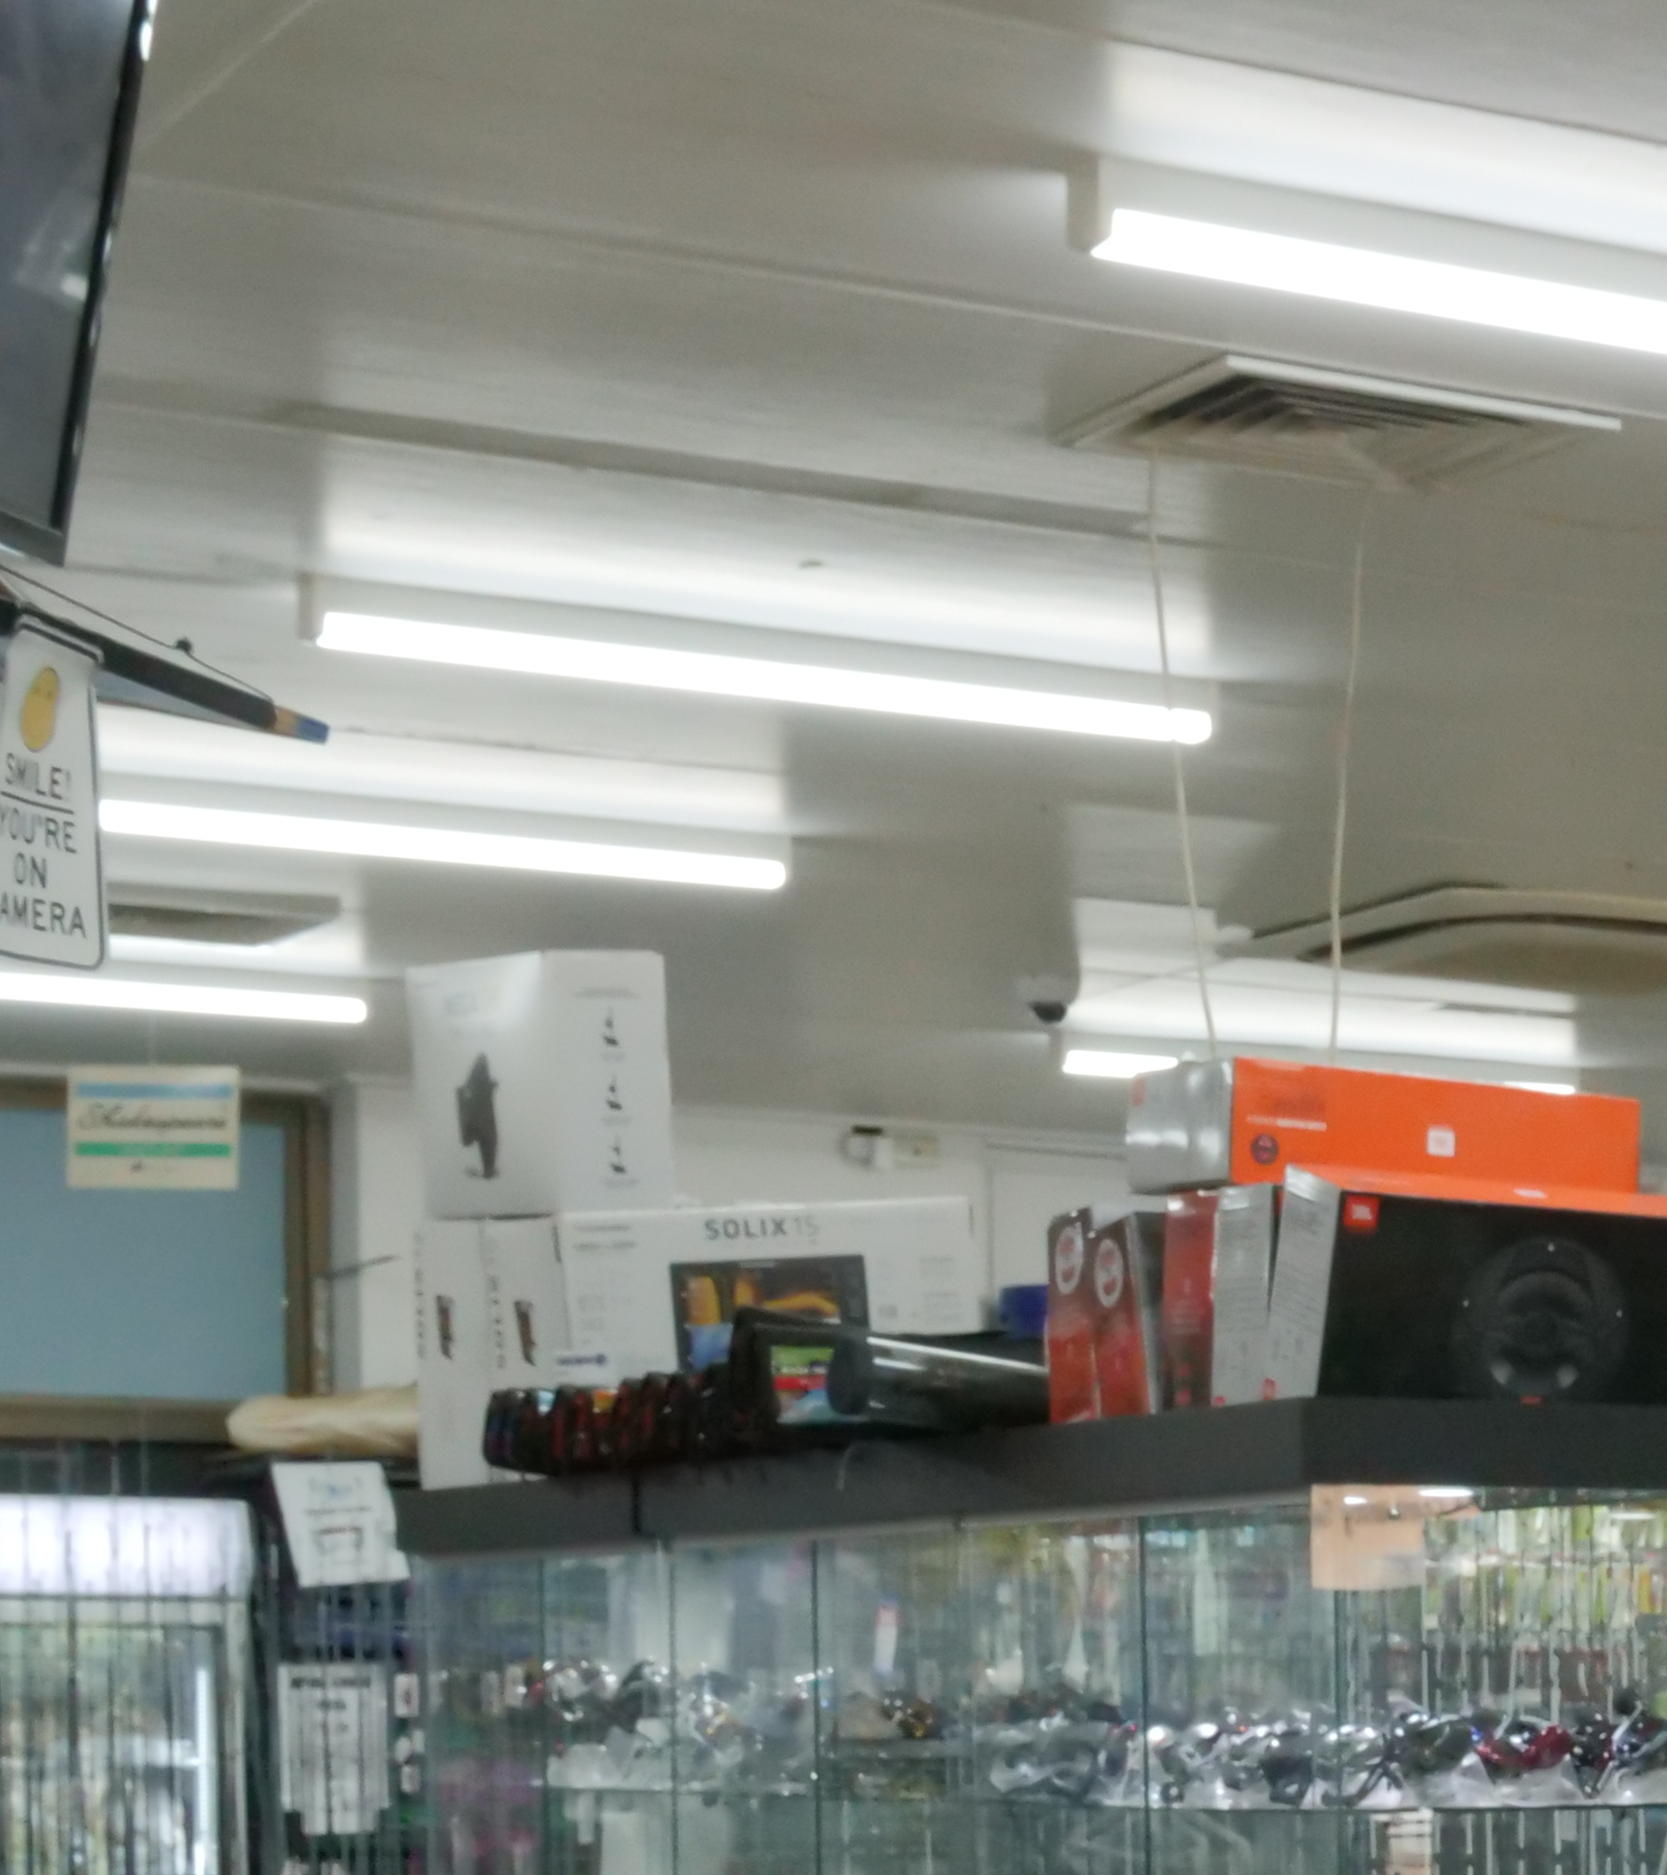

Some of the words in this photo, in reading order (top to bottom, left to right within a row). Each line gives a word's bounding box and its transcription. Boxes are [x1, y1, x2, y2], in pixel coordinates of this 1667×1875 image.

[5, 752, 72, 801] SMILE!
[13, 851, 48, 889] ON
[0, 892, 87, 939] AMERA
[703, 1217, 788, 1241] SOLIX
